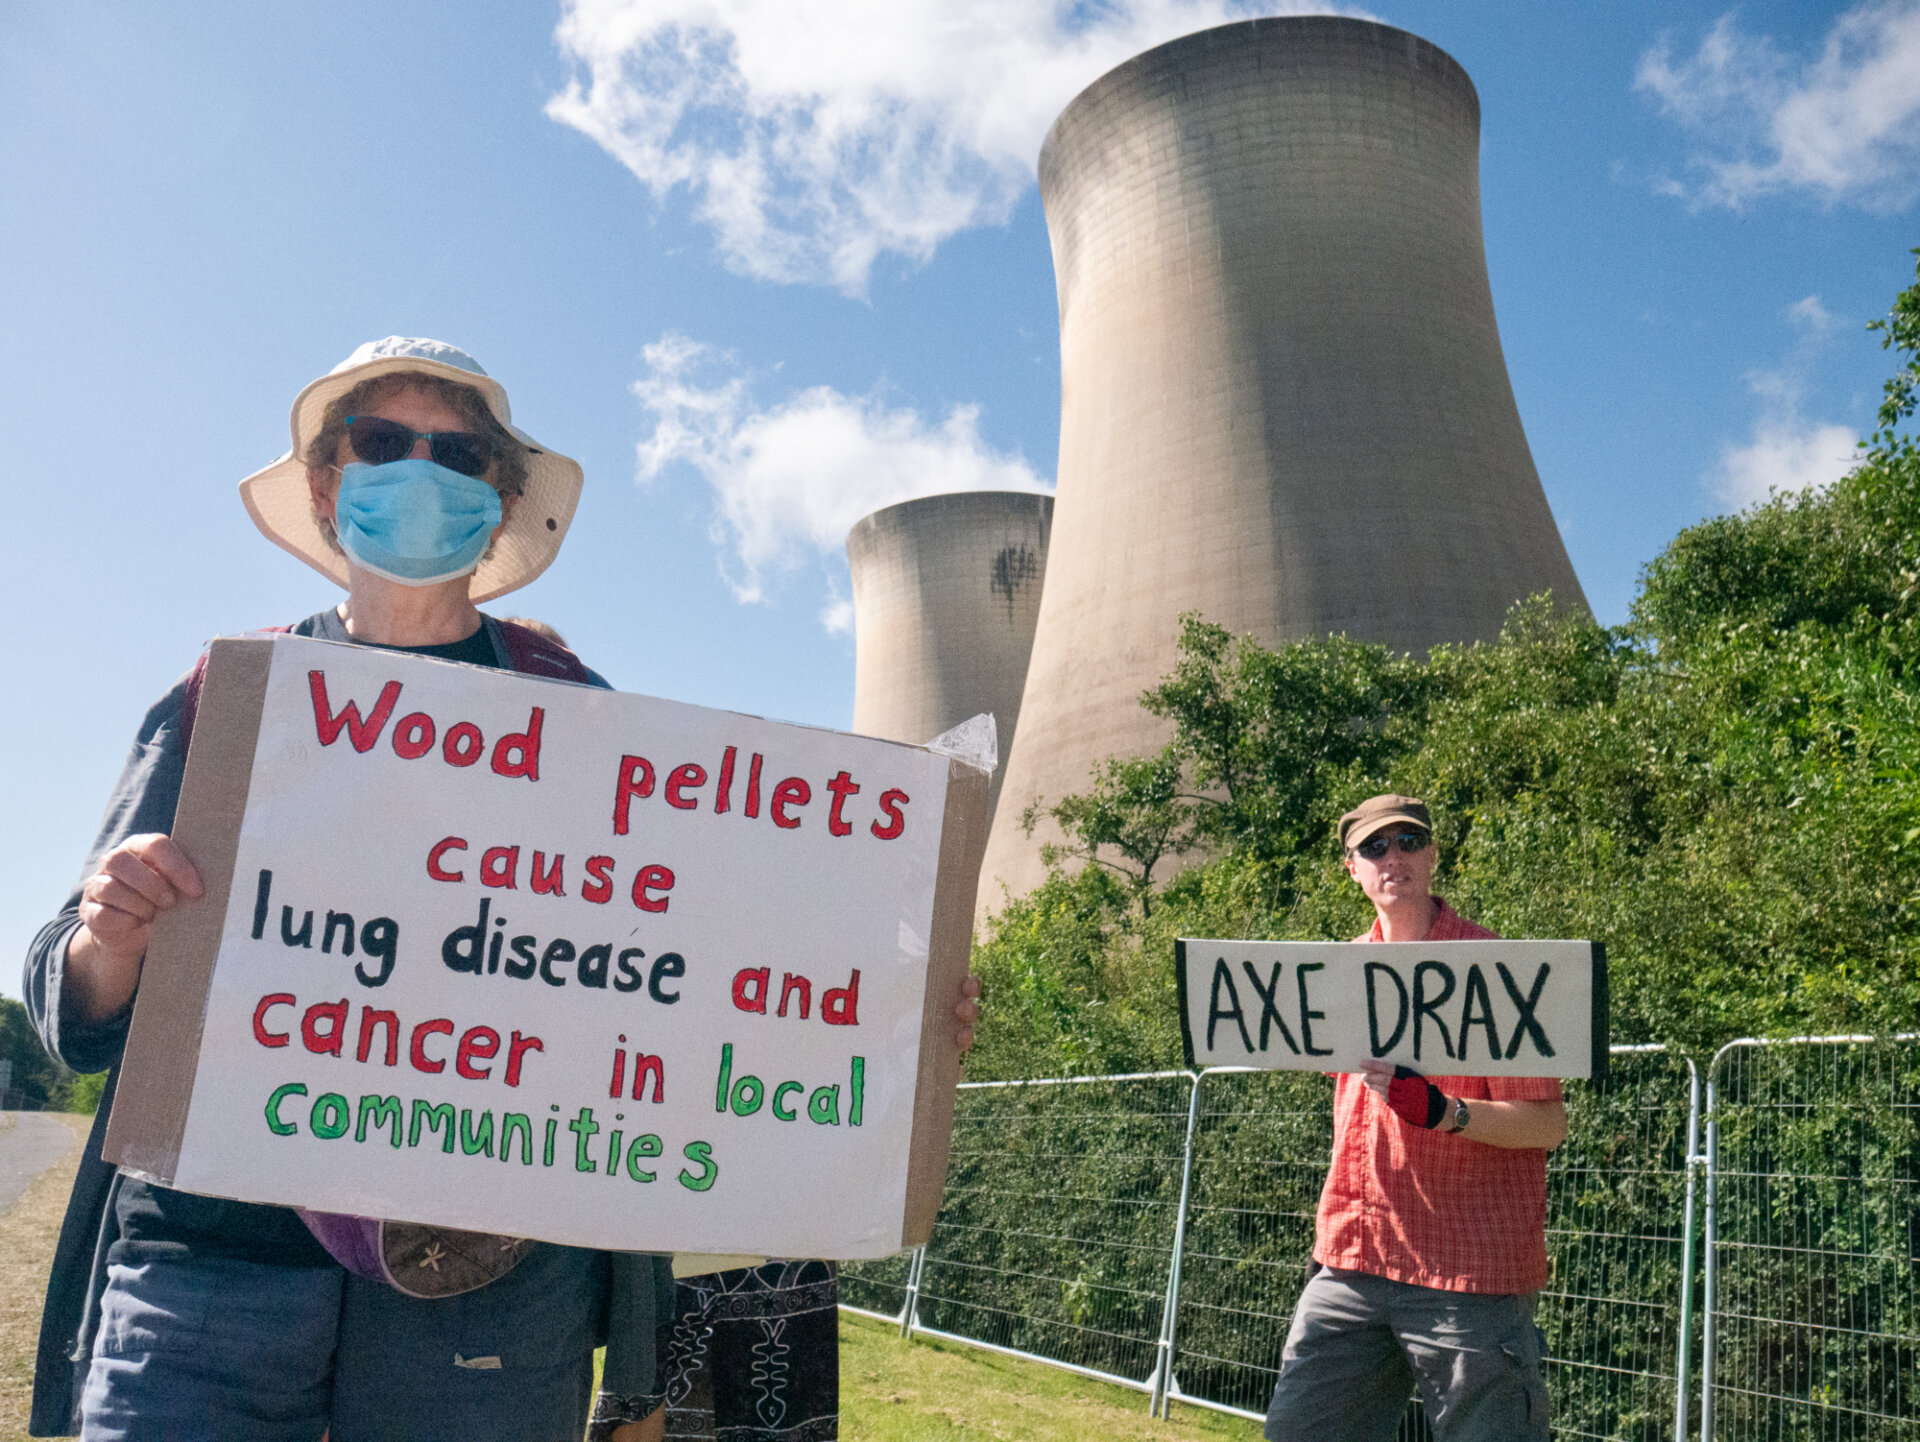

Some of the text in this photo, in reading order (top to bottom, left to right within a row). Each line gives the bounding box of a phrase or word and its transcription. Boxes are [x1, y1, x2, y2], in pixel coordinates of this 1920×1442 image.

[308, 670, 910, 841] Wood pellets
[427, 835, 675, 914] cause
[251, 869, 861, 1026] lung disease and
[252, 992, 866, 1127] cancer in local
[1206, 956, 1557, 1063] AXE DRAX
[264, 1082, 719, 1192] communities
